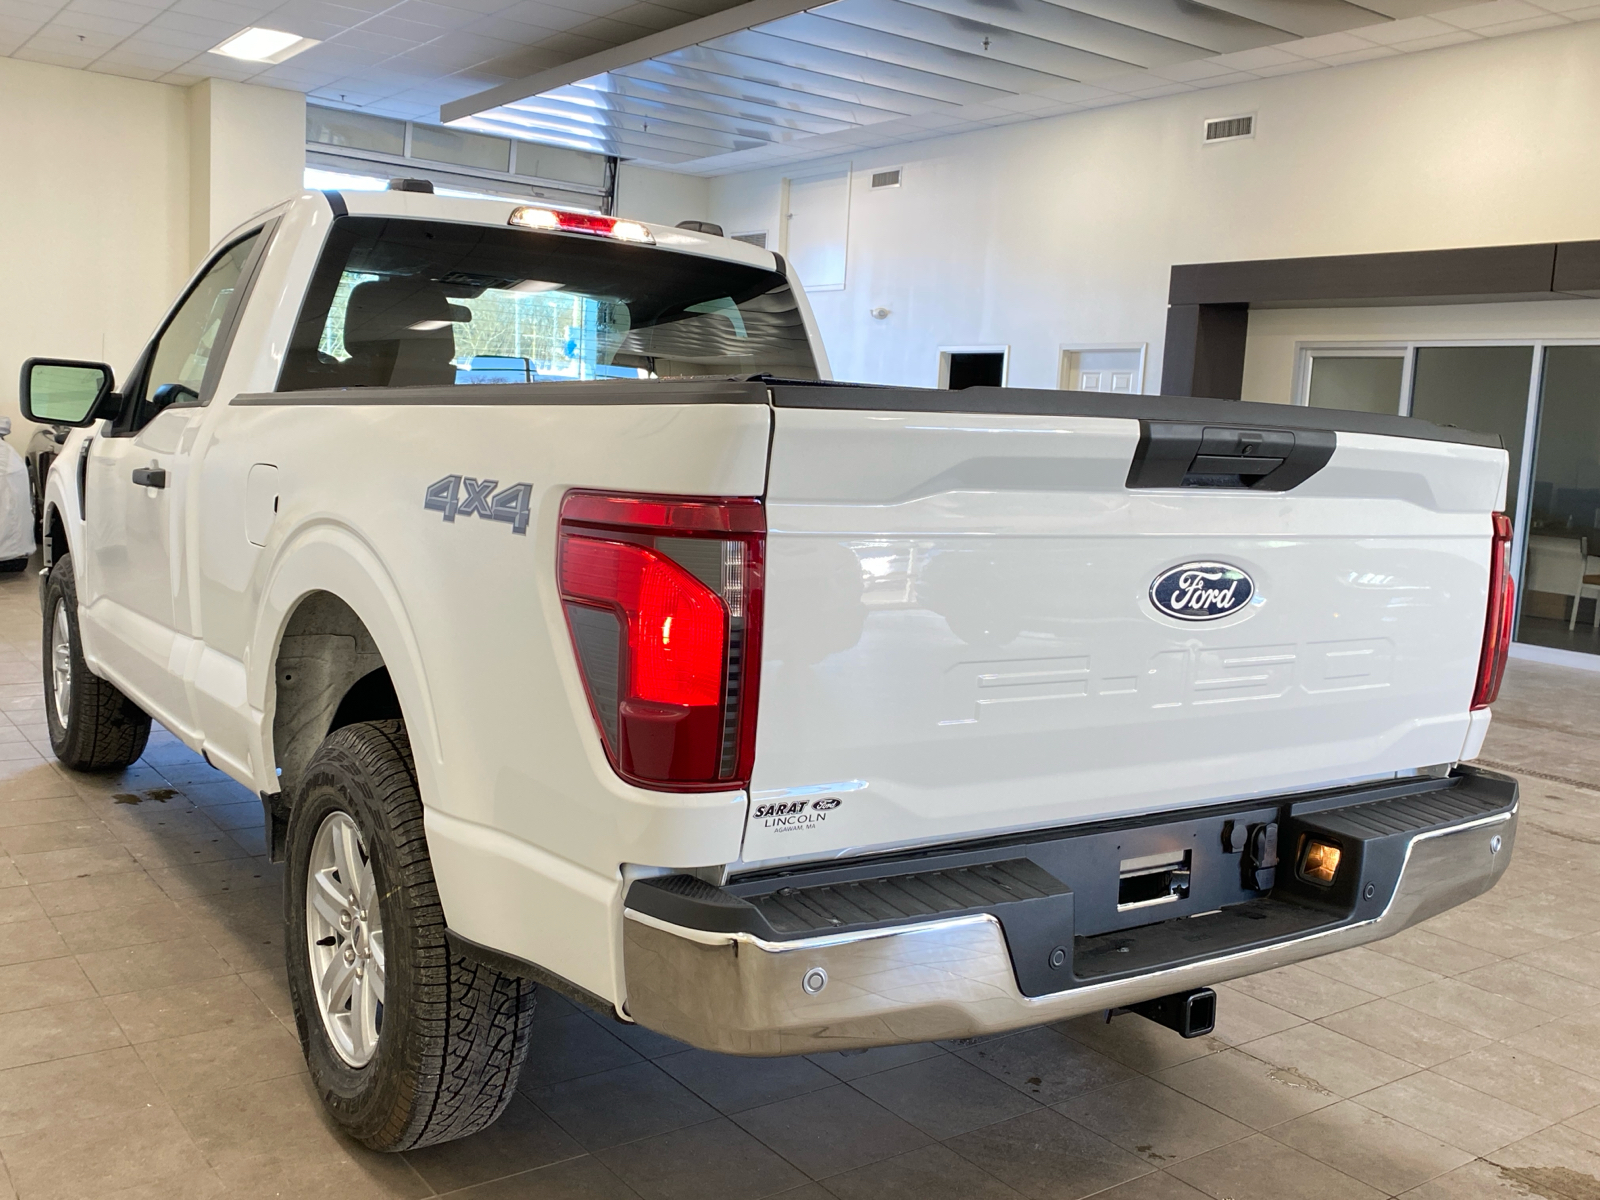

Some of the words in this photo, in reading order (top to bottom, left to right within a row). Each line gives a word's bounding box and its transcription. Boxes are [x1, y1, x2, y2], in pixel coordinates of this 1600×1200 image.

[1170, 569, 1239, 610] Ford
[753, 800, 809, 819] SARAT
[814, 798, 838, 810] Ford
[764, 812, 827, 828] LINCOLN
